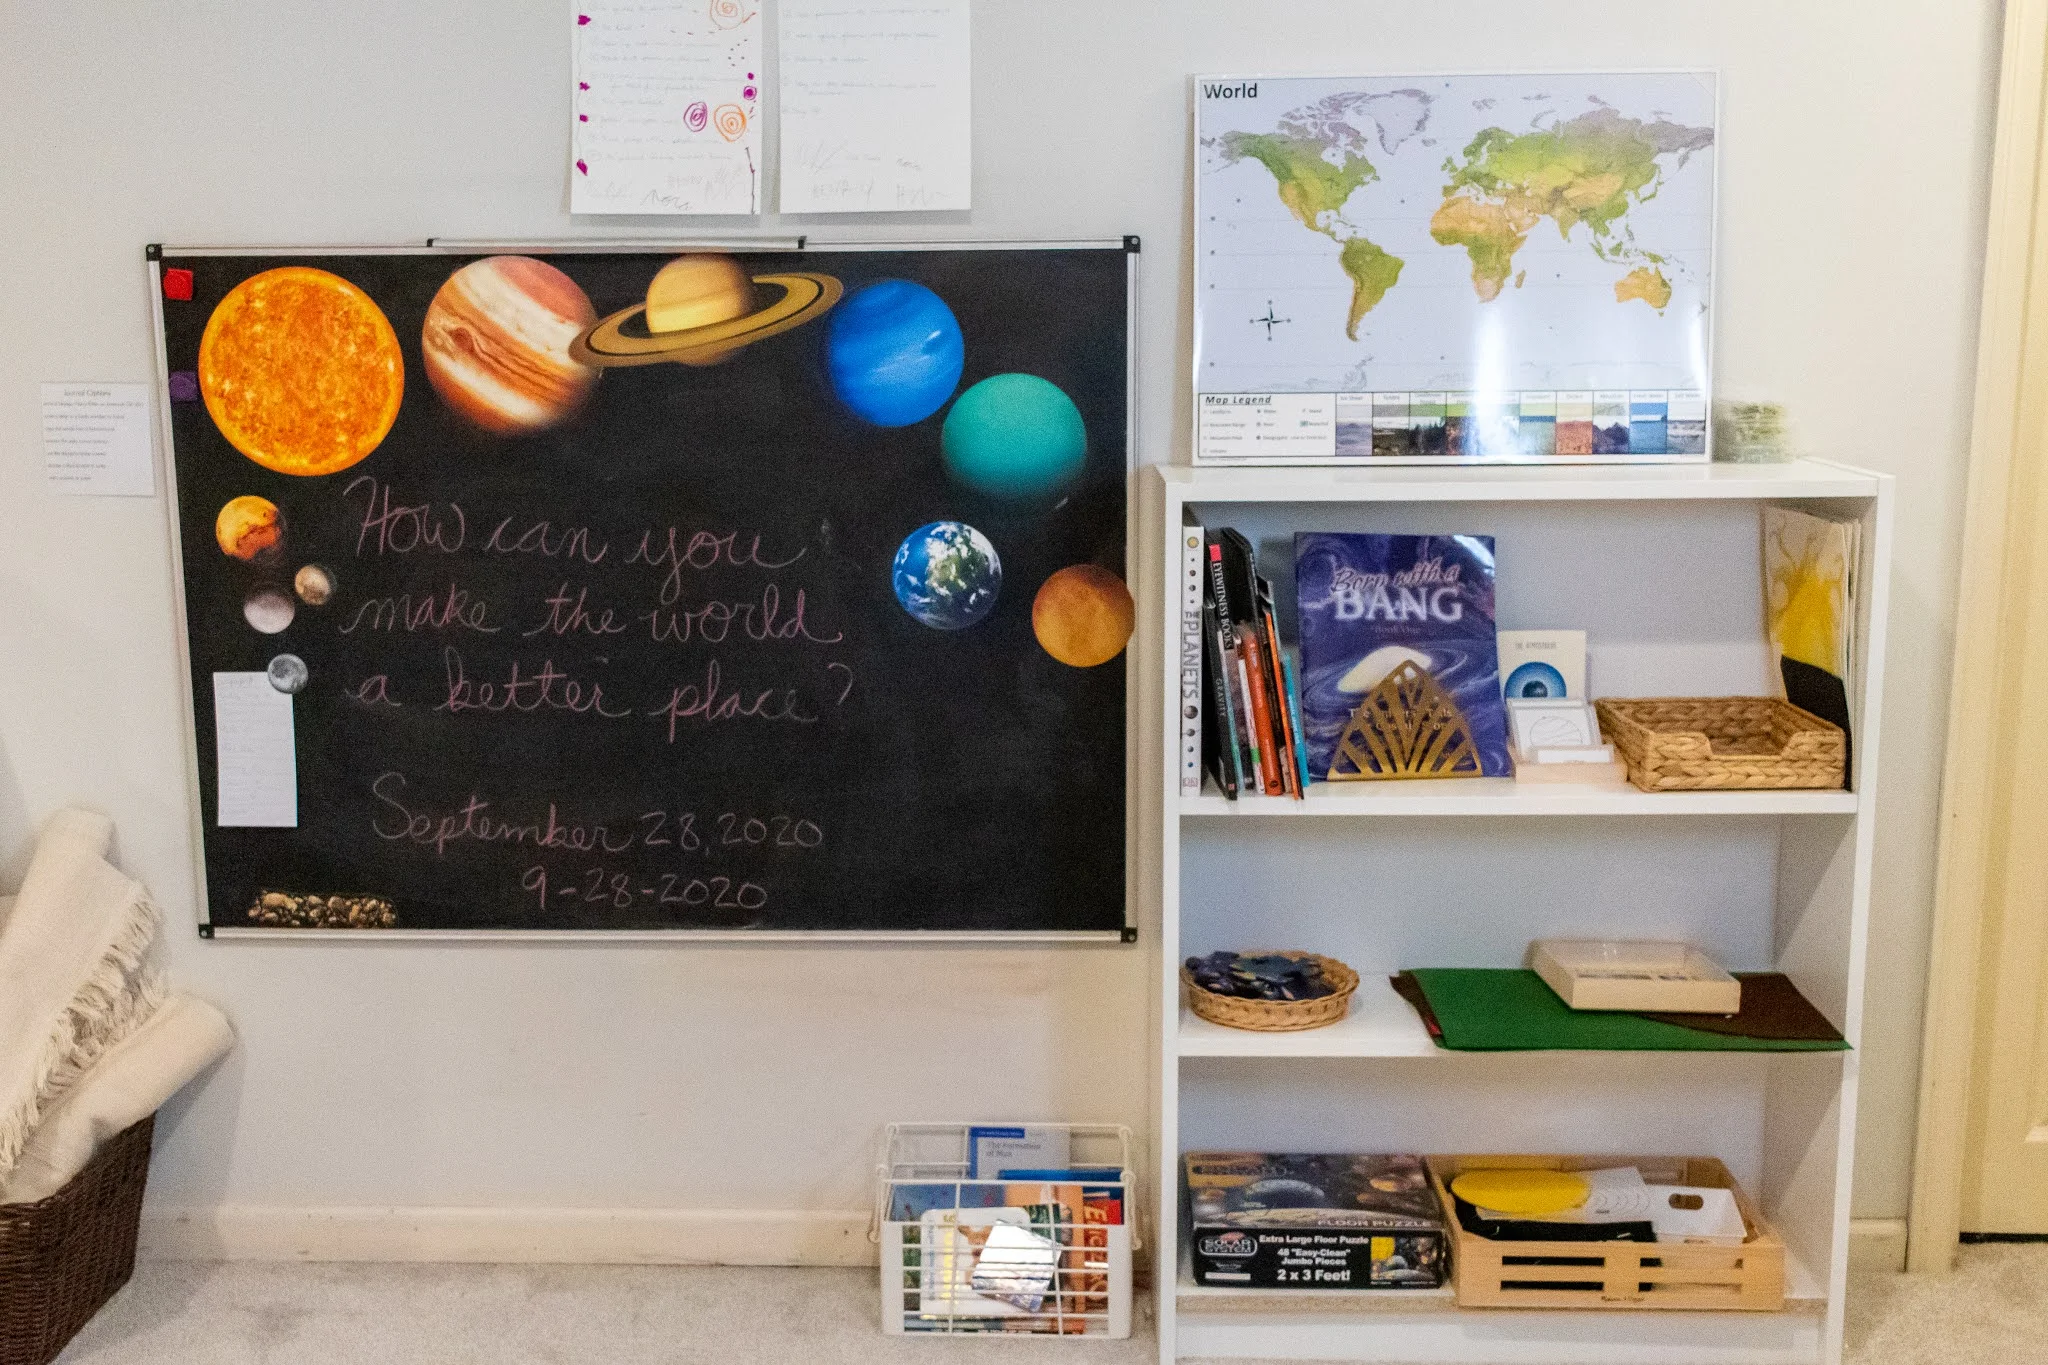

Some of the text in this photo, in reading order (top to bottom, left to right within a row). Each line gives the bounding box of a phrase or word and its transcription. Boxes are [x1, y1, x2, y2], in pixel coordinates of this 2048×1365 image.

[1203, 82, 1258, 99] World
[1205, 396, 1272, 405] Map Legend
[343, 476, 807, 605] How can you
[1331, 566, 1388, 593] Born
[338, 582, 844, 643] make the world
[1212, 561, 1234, 650] EYEWITNESS BOOKS
[1334, 585, 1462, 623] BANG
[1183, 619, 1200, 699] PLANETS
[345, 674, 403, 707] a
[433, 646, 633, 718] better
[1215, 677, 1227, 717] GRAVITY
[372, 772, 635, 855] September
[521, 865, 768, 910] 9-28-2020
[1259, 1234, 1369, 1245] Extra Large Floor Puzzle
[1318, 1219, 1430, 1228] FLOOR PUZZLE
[1276, 1268, 1351, 1282] 2 x 3 Feet!
[1281, 1257, 1347, 1266] Jumbo Pieces
